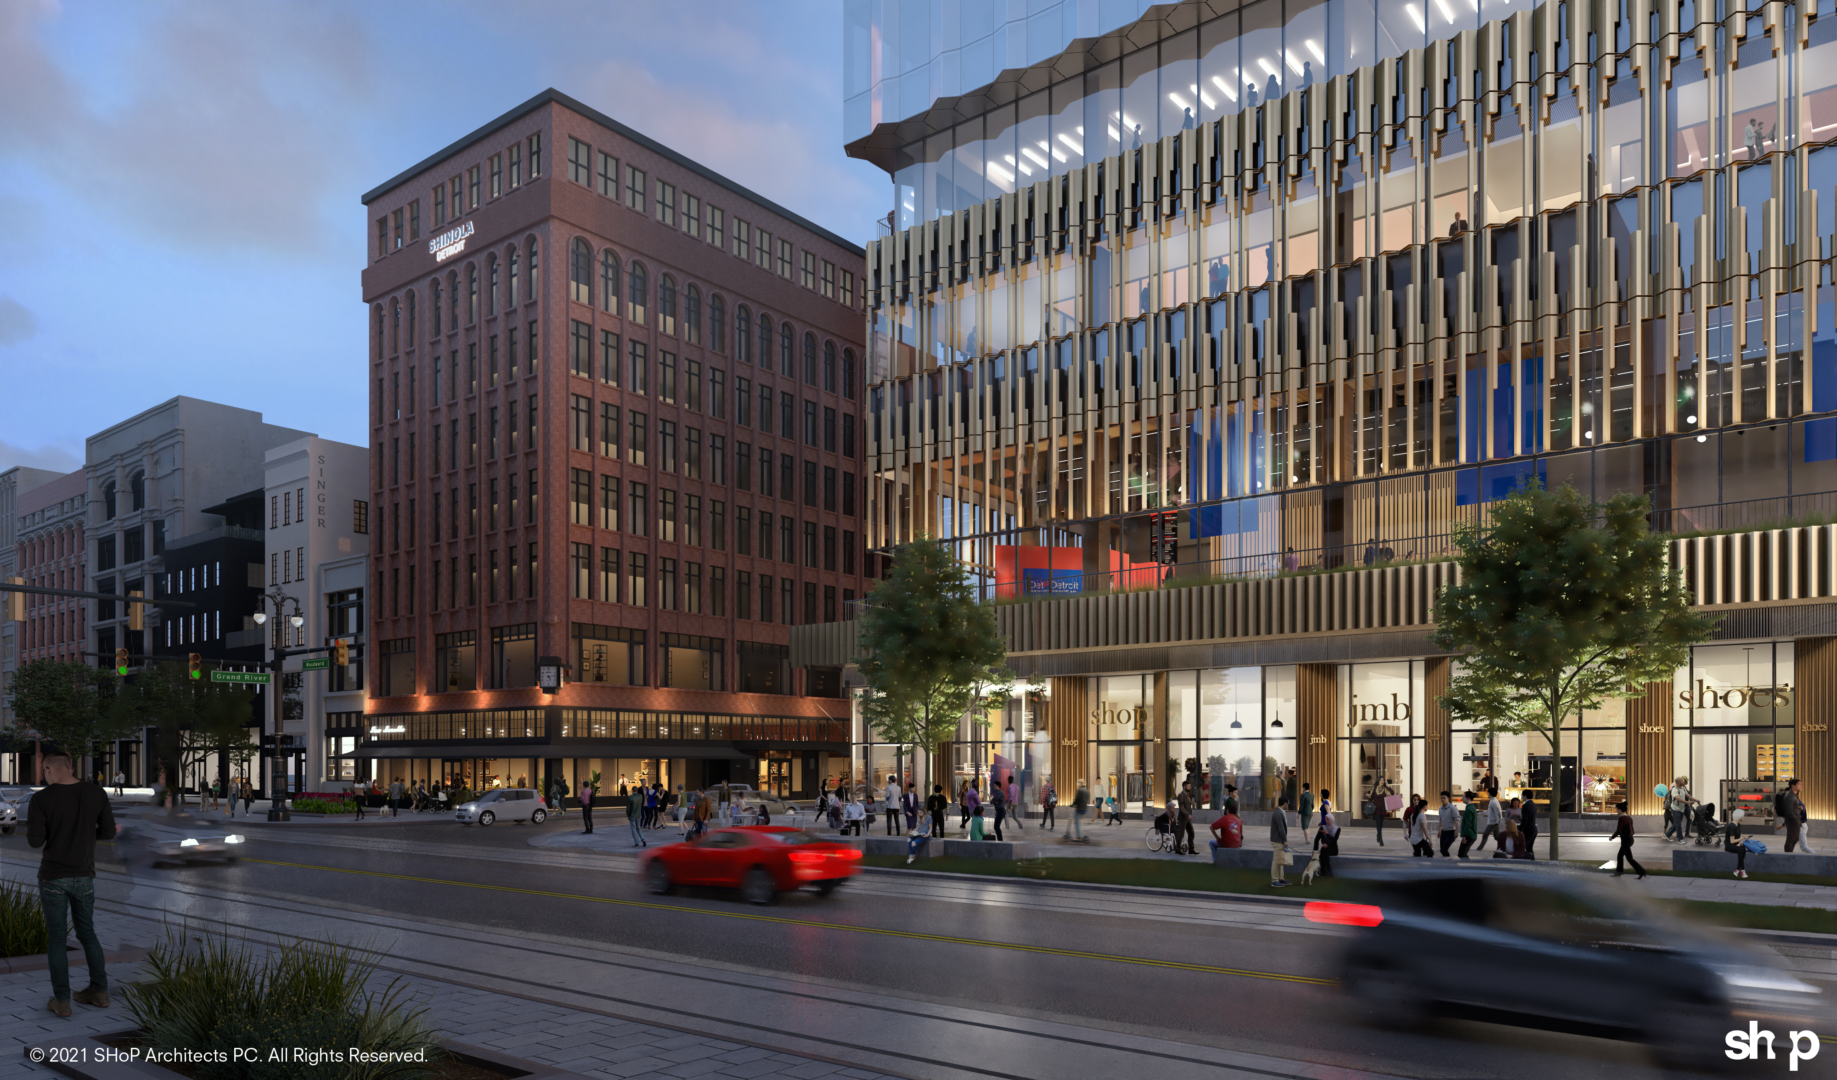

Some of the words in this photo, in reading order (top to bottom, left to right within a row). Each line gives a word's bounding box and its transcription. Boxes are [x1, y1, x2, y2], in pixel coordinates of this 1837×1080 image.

[428, 220, 475, 254] SHINOLA
[436, 239, 466, 262] DETROIT
[317, 454, 326, 528] SINGER
[216, 673, 241, 681] Grand
[244, 674, 267, 682] River
[1678, 678, 1790, 710] shoes
[1091, 700, 1148, 731] shop
[1346, 692, 1412, 729] jmb
[1638, 723, 1665, 734] shoes
[1801, 721, 1828, 732] shoes
[1061, 738, 1079, 748] shop
[1309, 734, 1327, 746] jmb
